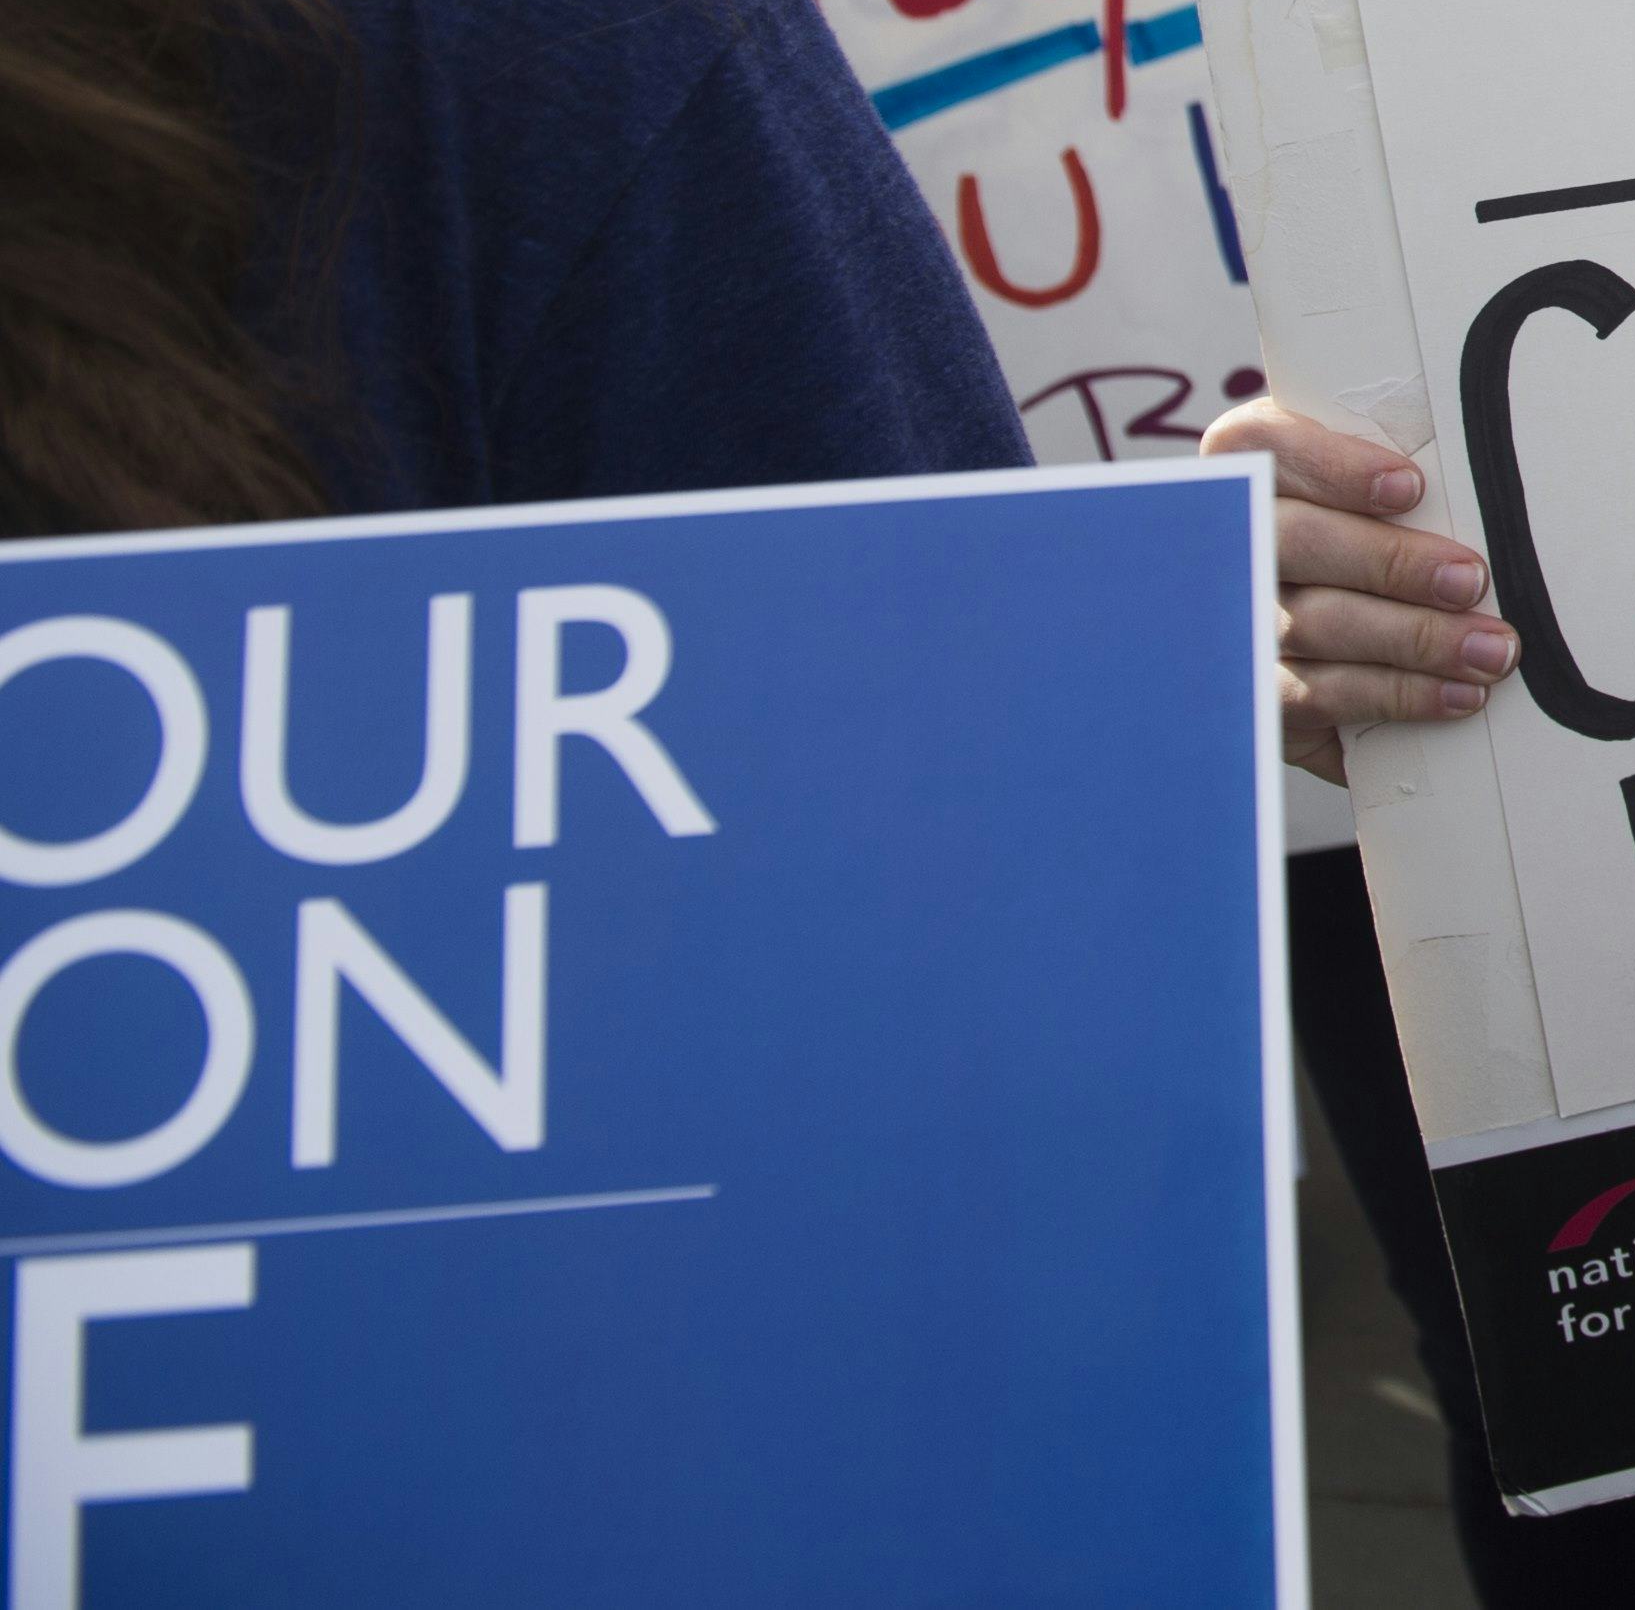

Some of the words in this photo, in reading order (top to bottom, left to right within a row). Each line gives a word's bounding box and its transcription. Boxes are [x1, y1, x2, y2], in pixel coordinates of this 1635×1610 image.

[0, 583, 720, 889] OUR
[0, 881, 549, 1190] ON
[1556, 1301, 1633, 1344] for
